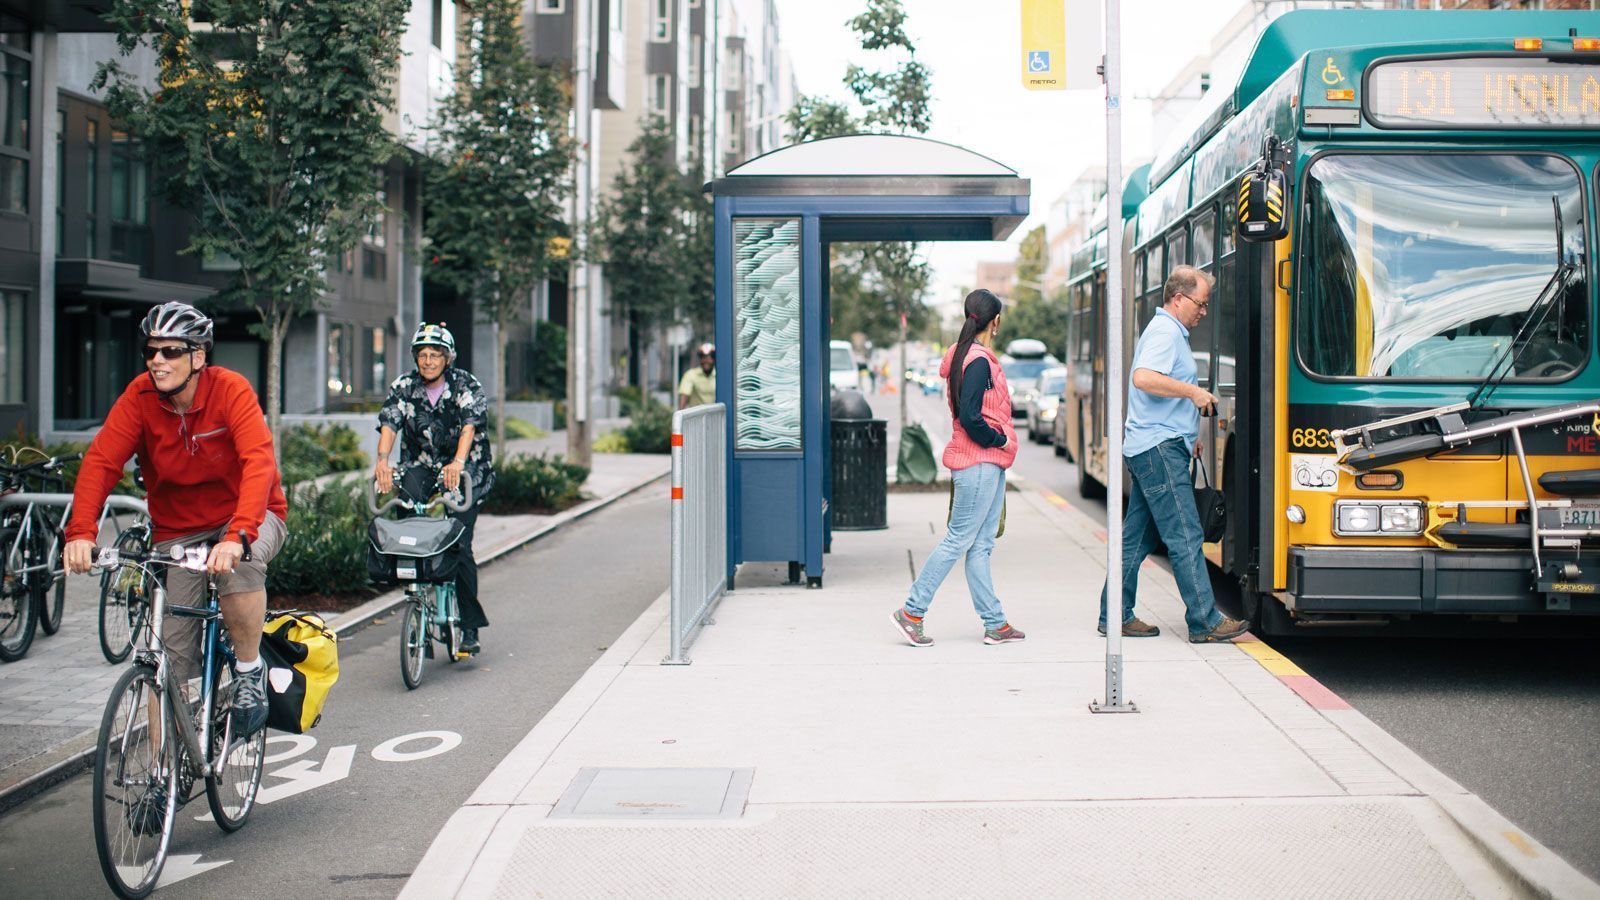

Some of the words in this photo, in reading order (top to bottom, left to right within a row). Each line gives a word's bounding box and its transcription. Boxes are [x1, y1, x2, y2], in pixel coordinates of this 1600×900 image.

[1397, 70, 1456, 115] 131
[1483, 71, 1600, 113] HIGHLA
[1567, 435, 1600, 453] ME
